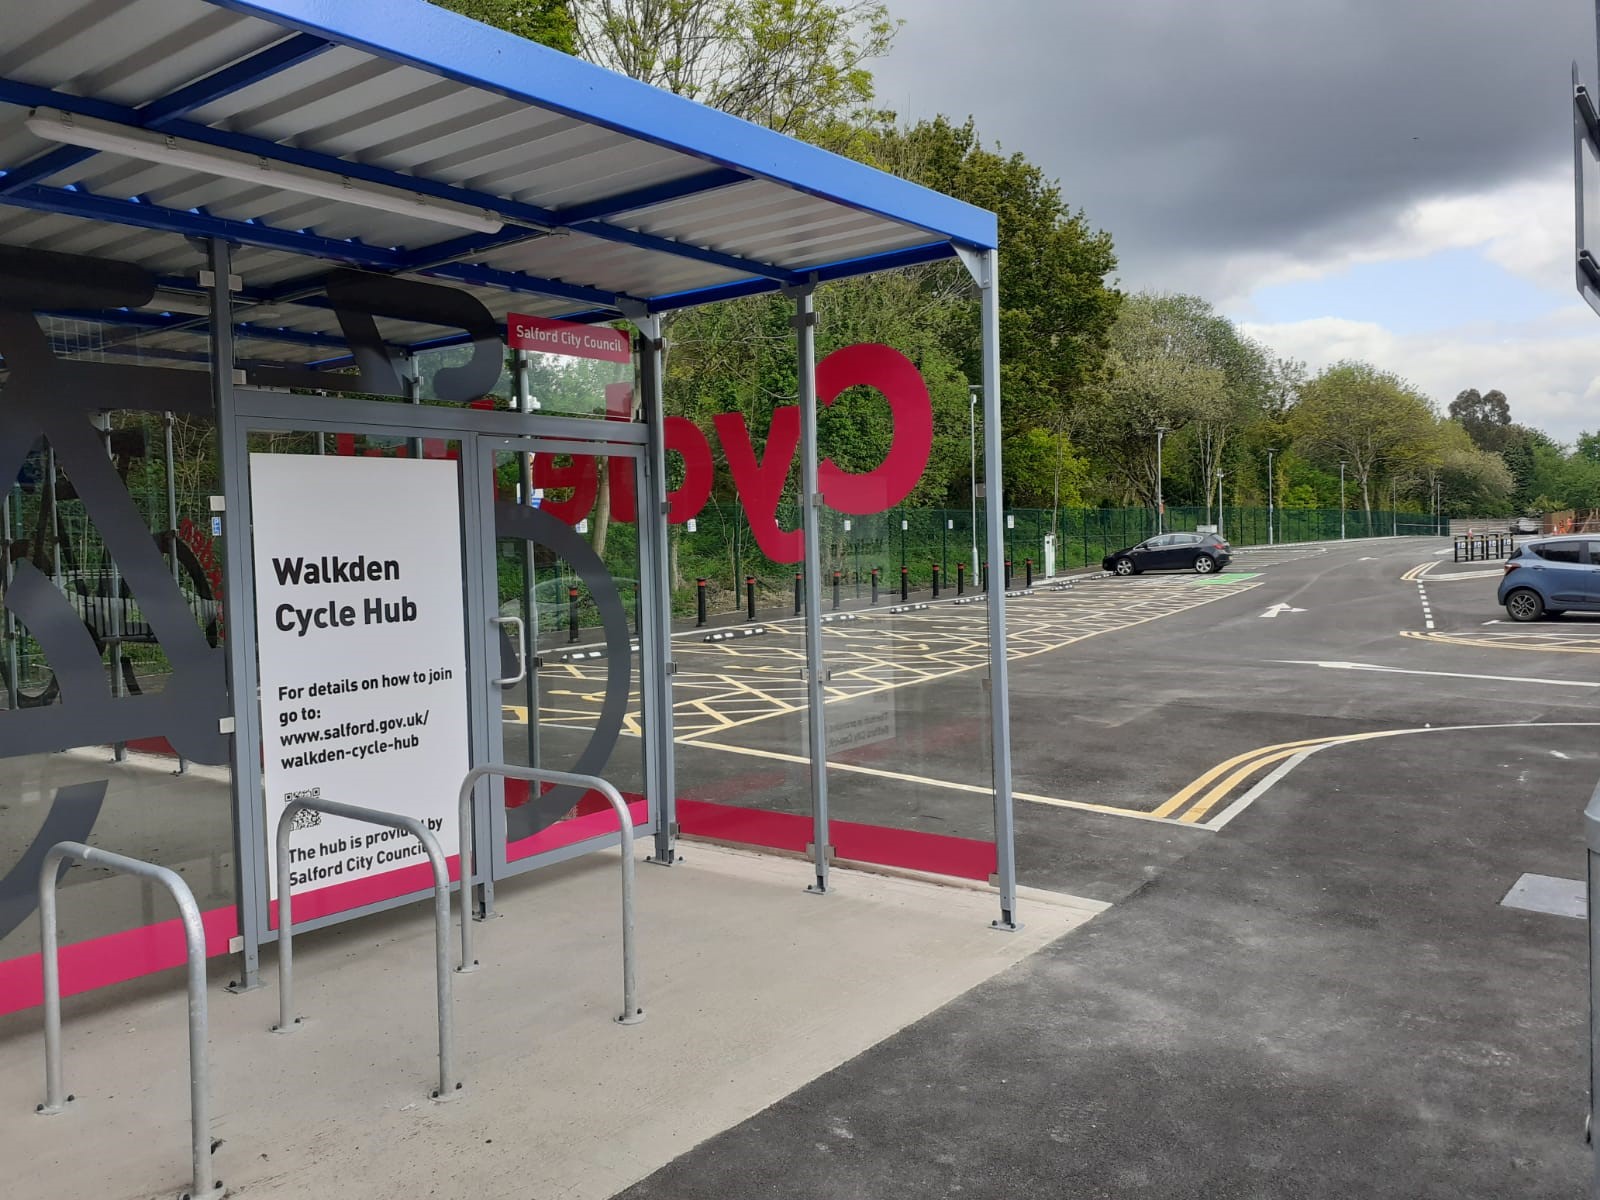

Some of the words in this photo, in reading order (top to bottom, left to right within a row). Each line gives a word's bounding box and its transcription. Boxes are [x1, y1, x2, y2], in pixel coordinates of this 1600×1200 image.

[516, 325, 558, 343] Salford
[561, 331, 581, 348] City
[584, 336, 622, 352] Council
[272, 555, 400, 586] Walkden
[275, 601, 356, 637] Cycle
[363, 596, 417, 625] Hub
[278, 686, 305, 701] For
[308, 678, 358, 697] details
[361, 677, 379, 690] on
[381, 674, 410, 688] how
[413, 671, 426, 684] to
[428, 667, 452, 685] join
[279, 711, 298, 726] go
[301, 708, 321, 721] to:
[280, 710, 429, 747] www.salford.gov.uk/
[281, 734, 419, 769] walkden-cycle-hub
[289, 847, 316, 863] The
[320, 838, 347, 857] hub
[350, 835, 362, 849] is
[428, 818, 443, 831] by
[289, 860, 343, 886] Salford
[347, 856, 373, 871] City
